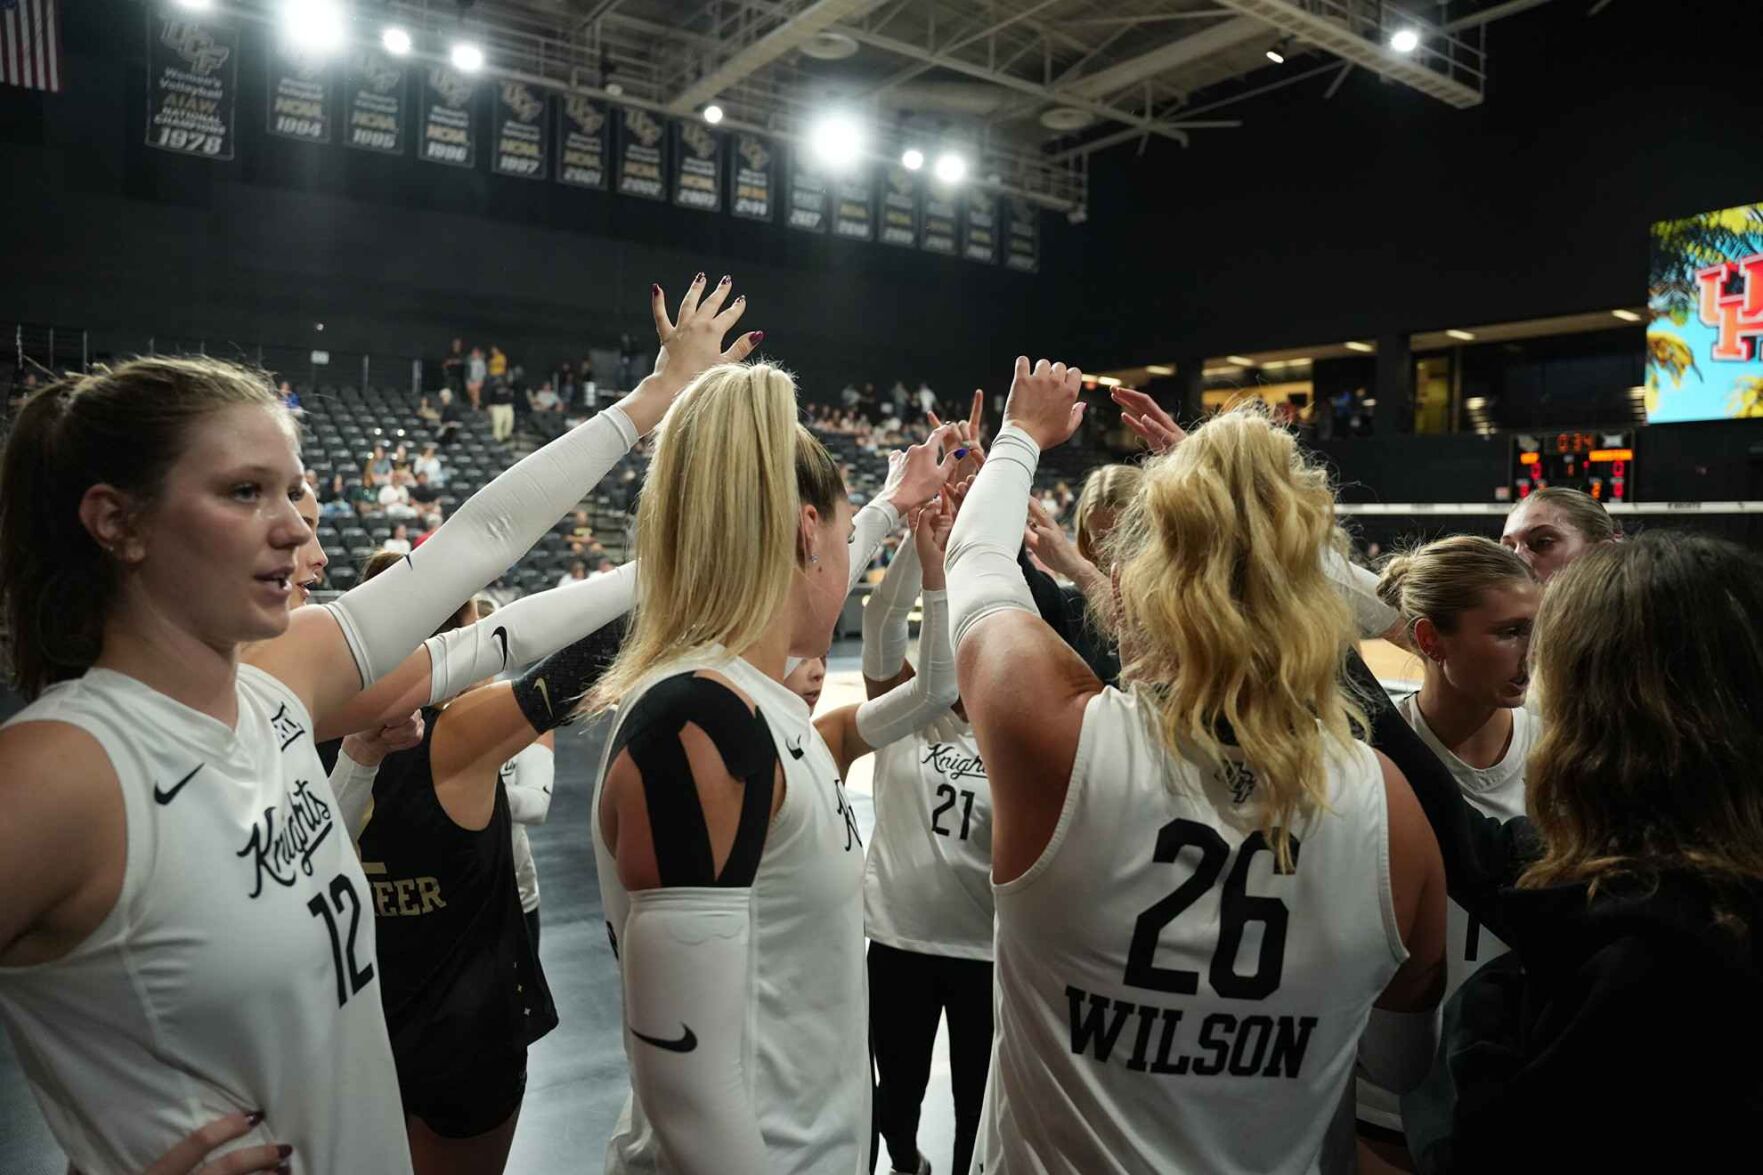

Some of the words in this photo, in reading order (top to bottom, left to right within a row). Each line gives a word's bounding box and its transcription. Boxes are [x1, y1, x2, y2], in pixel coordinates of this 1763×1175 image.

[159, 126, 223, 155] 1978
[921, 743, 989, 780] Knigh
[236, 779, 333, 899] Knights
[931, 783, 976, 841] 21
[370, 876, 447, 918] EER
[1123, 817, 1301, 1001] 26
[307, 873, 375, 1009] 12
[1065, 984, 1319, 1079] WILSON
